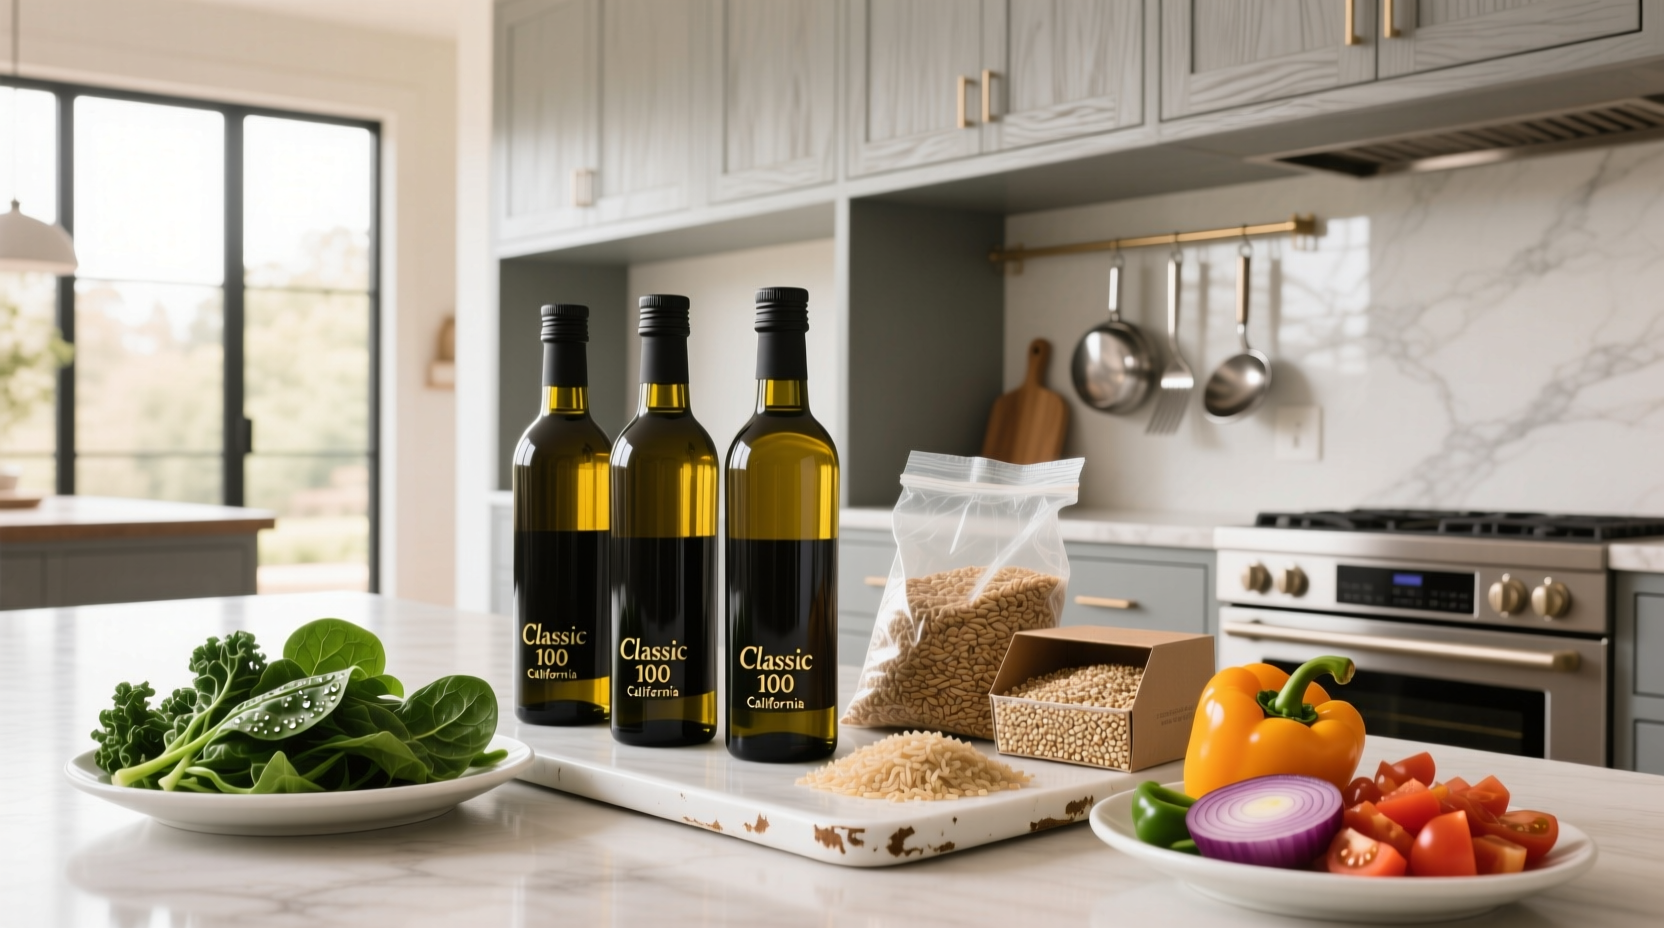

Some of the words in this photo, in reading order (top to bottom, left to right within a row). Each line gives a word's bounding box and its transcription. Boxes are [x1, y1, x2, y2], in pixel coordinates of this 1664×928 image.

[522, 623, 587, 645] Classic
[535, 648, 568, 666] 100
[620, 637, 687, 660] Classic
[740, 645, 813, 670] Classic
[635, 664, 671, 683] 100
[757, 673, 794, 693] 100
